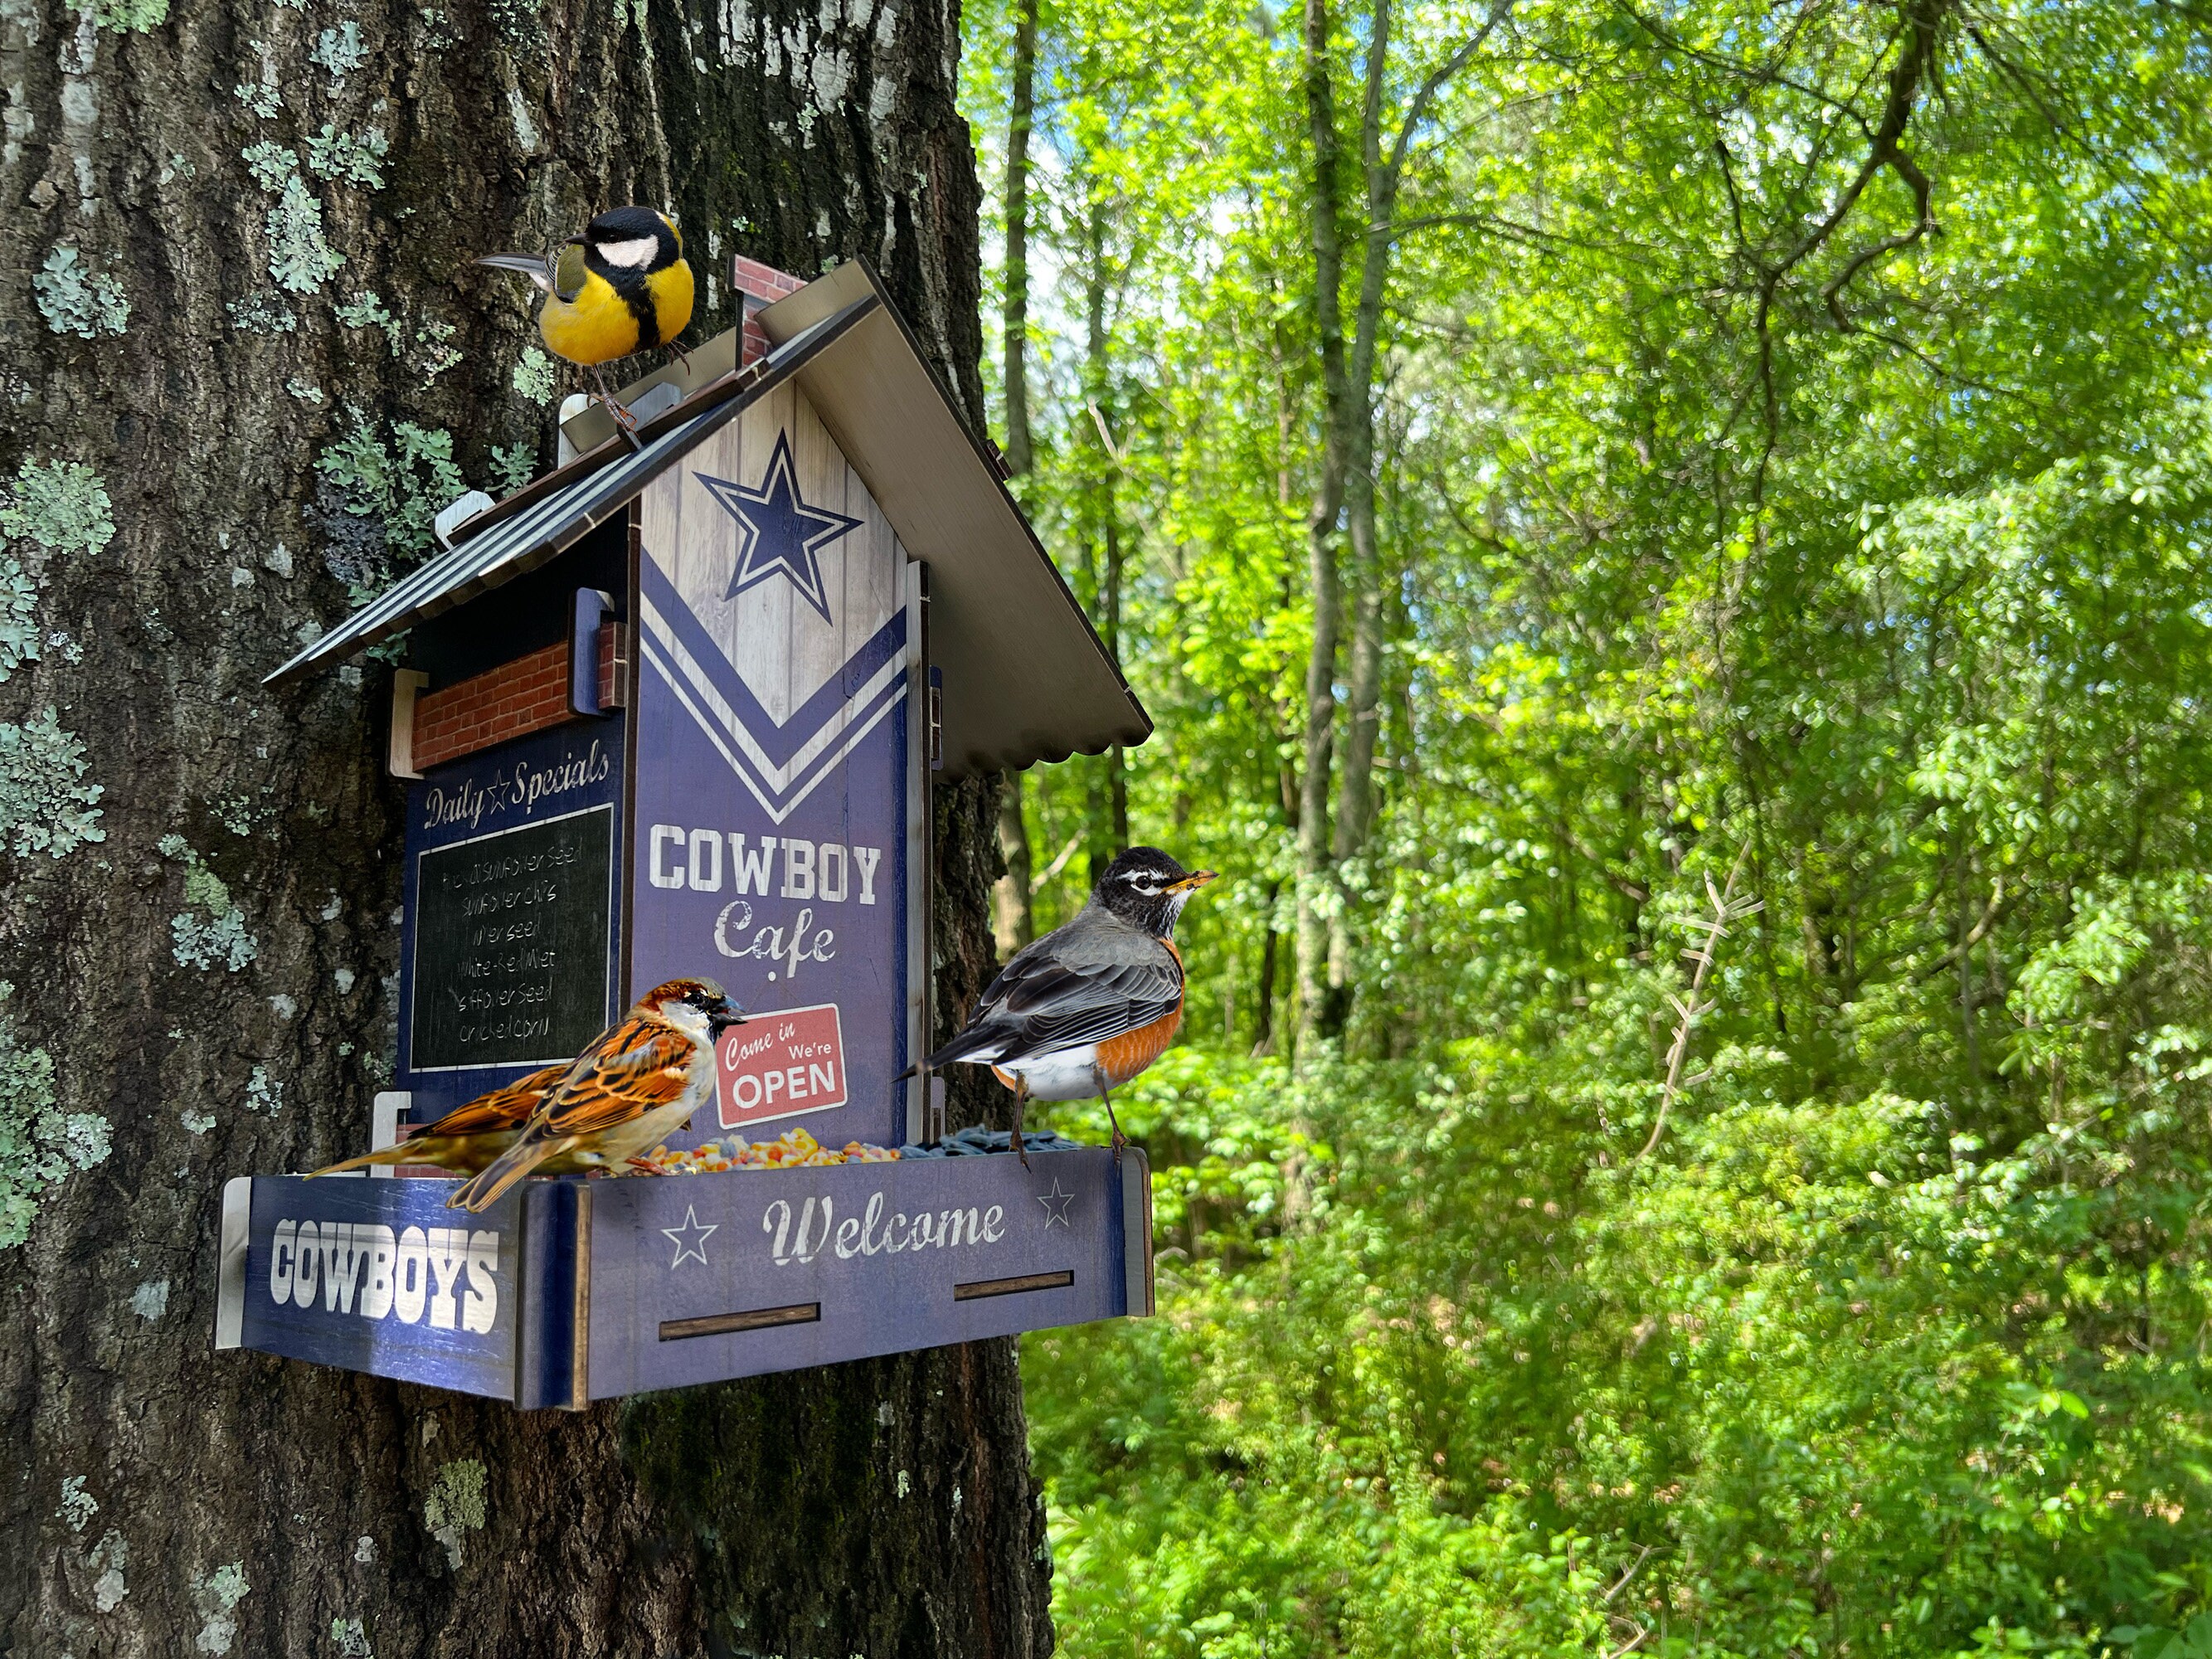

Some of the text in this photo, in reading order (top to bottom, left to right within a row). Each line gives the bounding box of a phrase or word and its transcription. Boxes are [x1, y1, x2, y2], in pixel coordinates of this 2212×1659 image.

[424, 738, 610, 830] Daily Specials
[649, 824, 882, 906] COWBOY
[713, 900, 836, 979] Cafe
[725, 1021, 796, 1073] Come in
[732, 1060, 836, 1110] OPEN
[787, 1042, 832, 1061] We're
[761, 1190, 1006, 1267] Welcome
[270, 1218, 499, 1335] COWBOYS
